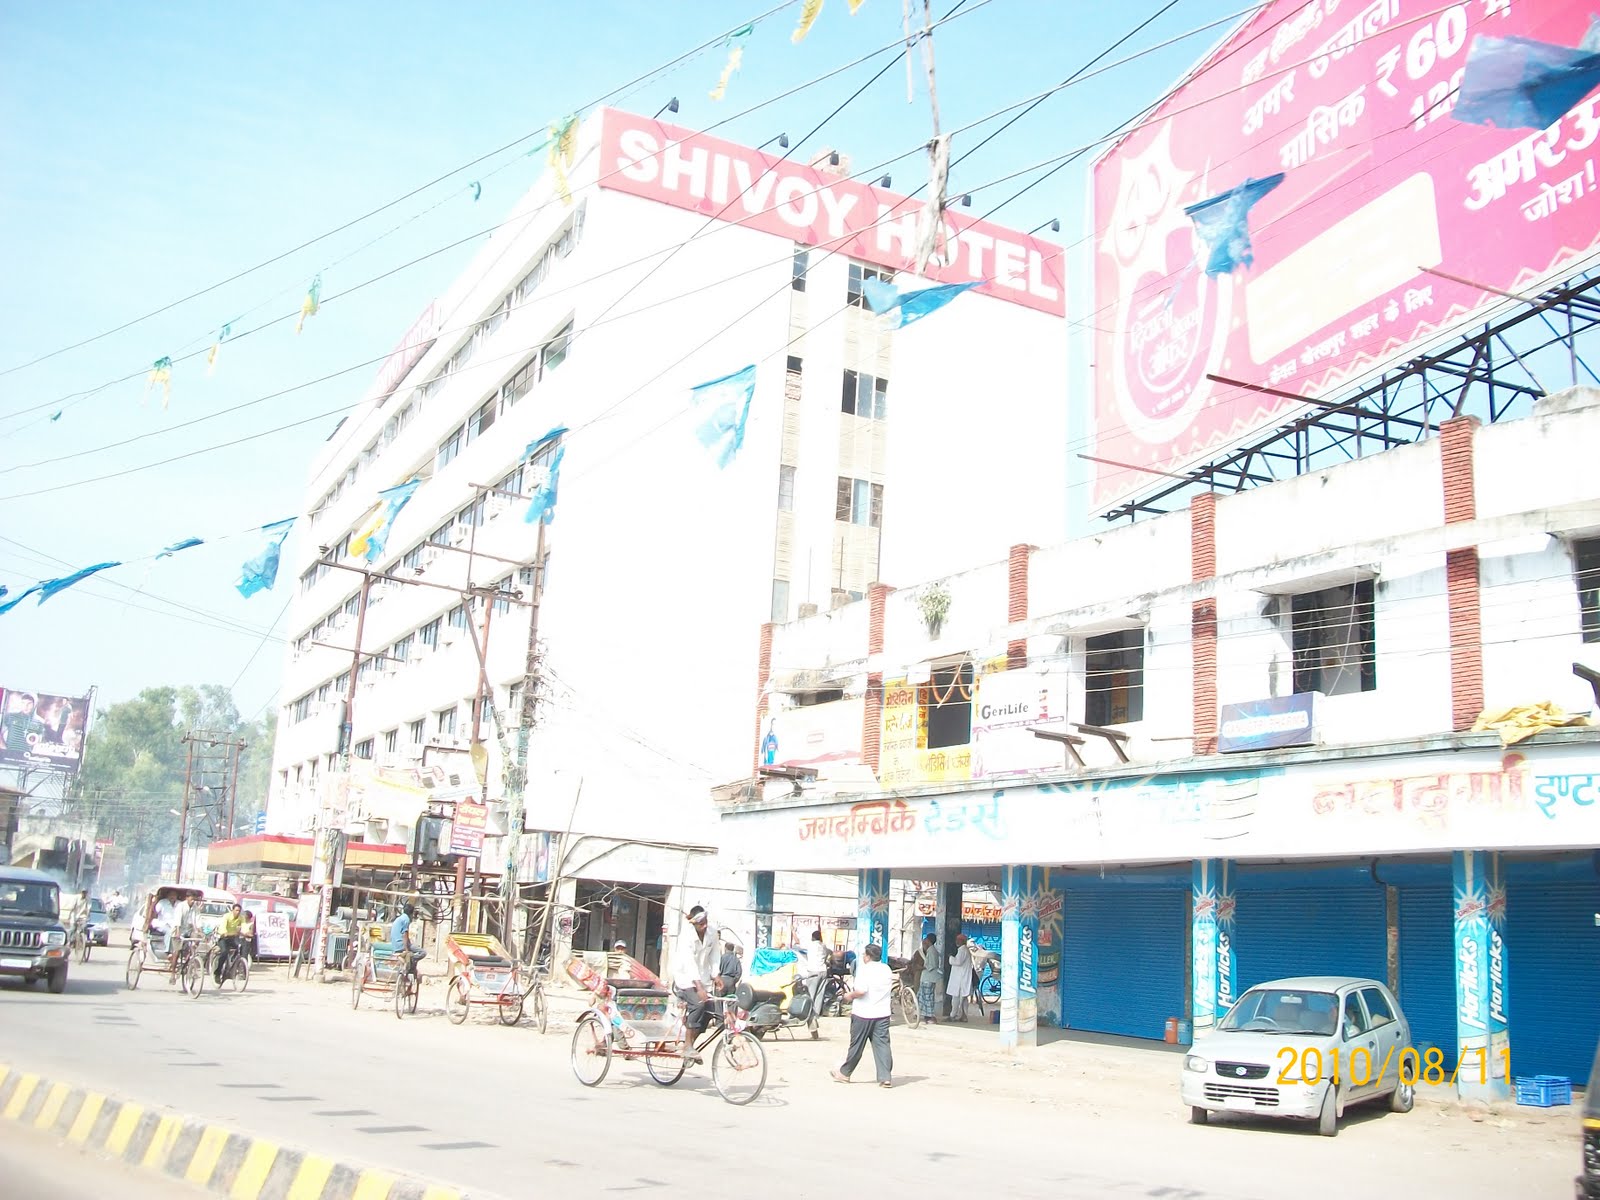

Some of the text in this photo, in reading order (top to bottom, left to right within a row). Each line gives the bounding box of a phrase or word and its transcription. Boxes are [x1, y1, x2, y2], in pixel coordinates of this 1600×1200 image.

[1242, 70, 1297, 135] अमर
[1308, 0, 1400, 79] उजाला
[1279, 84, 1366, 167] मासिक
[1406, 4, 1468, 80] 60
[616, 129, 1059, 302] SHIVOY HOTEL
[981, 702, 1029, 720] GeriLife
[1535, 772, 1600, 820] इण्ट
[1019, 925, 1037, 994] Horlicks
[1216, 931, 1235, 1009] Horlicks
[1458, 935, 1488, 1031] Horlicks
[1489, 930, 1508, 1025] Horlicks
